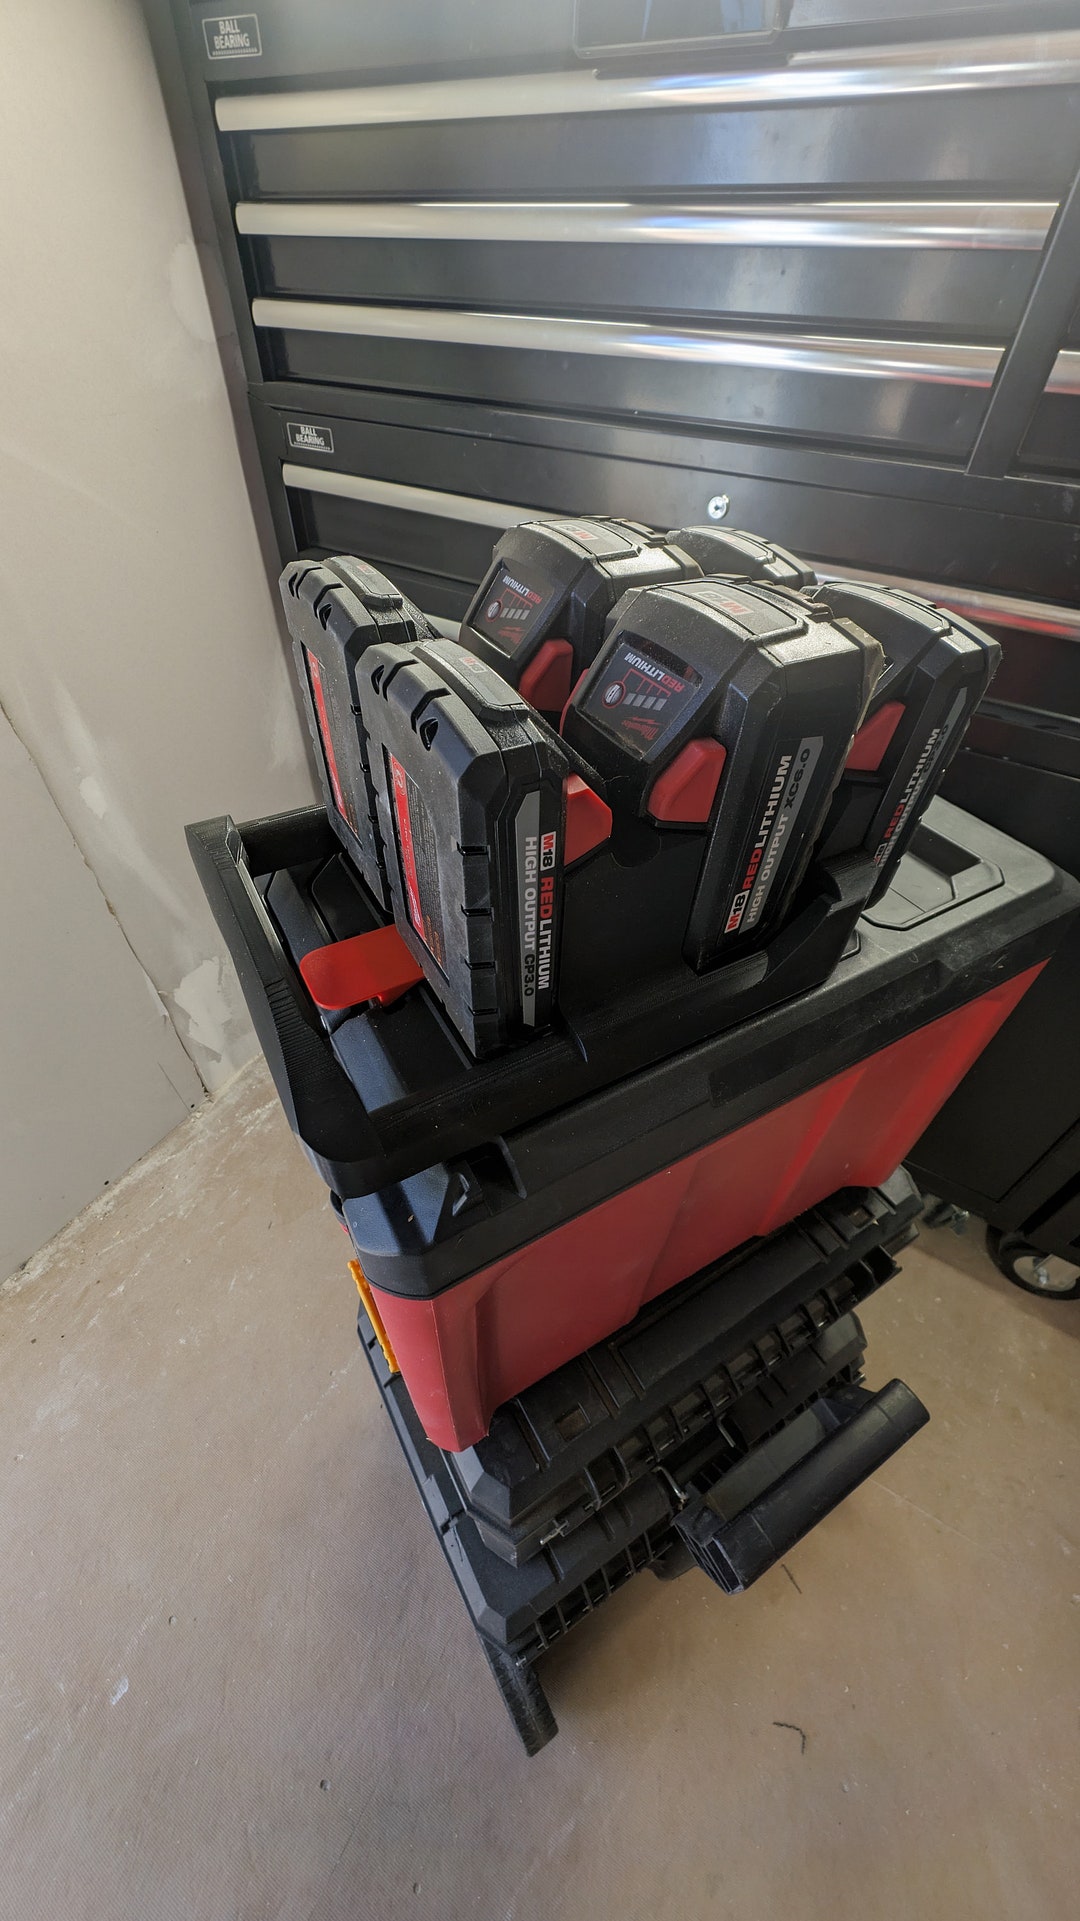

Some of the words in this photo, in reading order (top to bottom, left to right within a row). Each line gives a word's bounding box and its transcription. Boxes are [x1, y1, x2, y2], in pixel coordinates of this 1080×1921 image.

[213, 33, 250, 49] BEARING
[218, 19, 240, 34] BALL
[295, 433, 325, 446] BEARING
[300, 426, 317, 437] BALL
[503, 575, 543, 604] REDLITHIUM
[624, 652, 686, 693] REDLITHIUM
[884, 728, 941, 839] REDLITHIUM
[895, 778, 924, 832] OUTPUT
[543, 834, 554, 868] M18
[727, 894, 746, 931] M18
[742, 755, 792, 889] REDLITHIUM
[747, 885, 766, 923] HIGH
[761, 814, 789, 881] OUTPUT
[784, 748, 810, 809] XC6.0
[525, 836, 537, 883] HIGH
[524, 885, 536, 950] OUTPUT
[538, 876, 554, 990] REDLITHIUM
[524, 953, 535, 997] CP3.0
